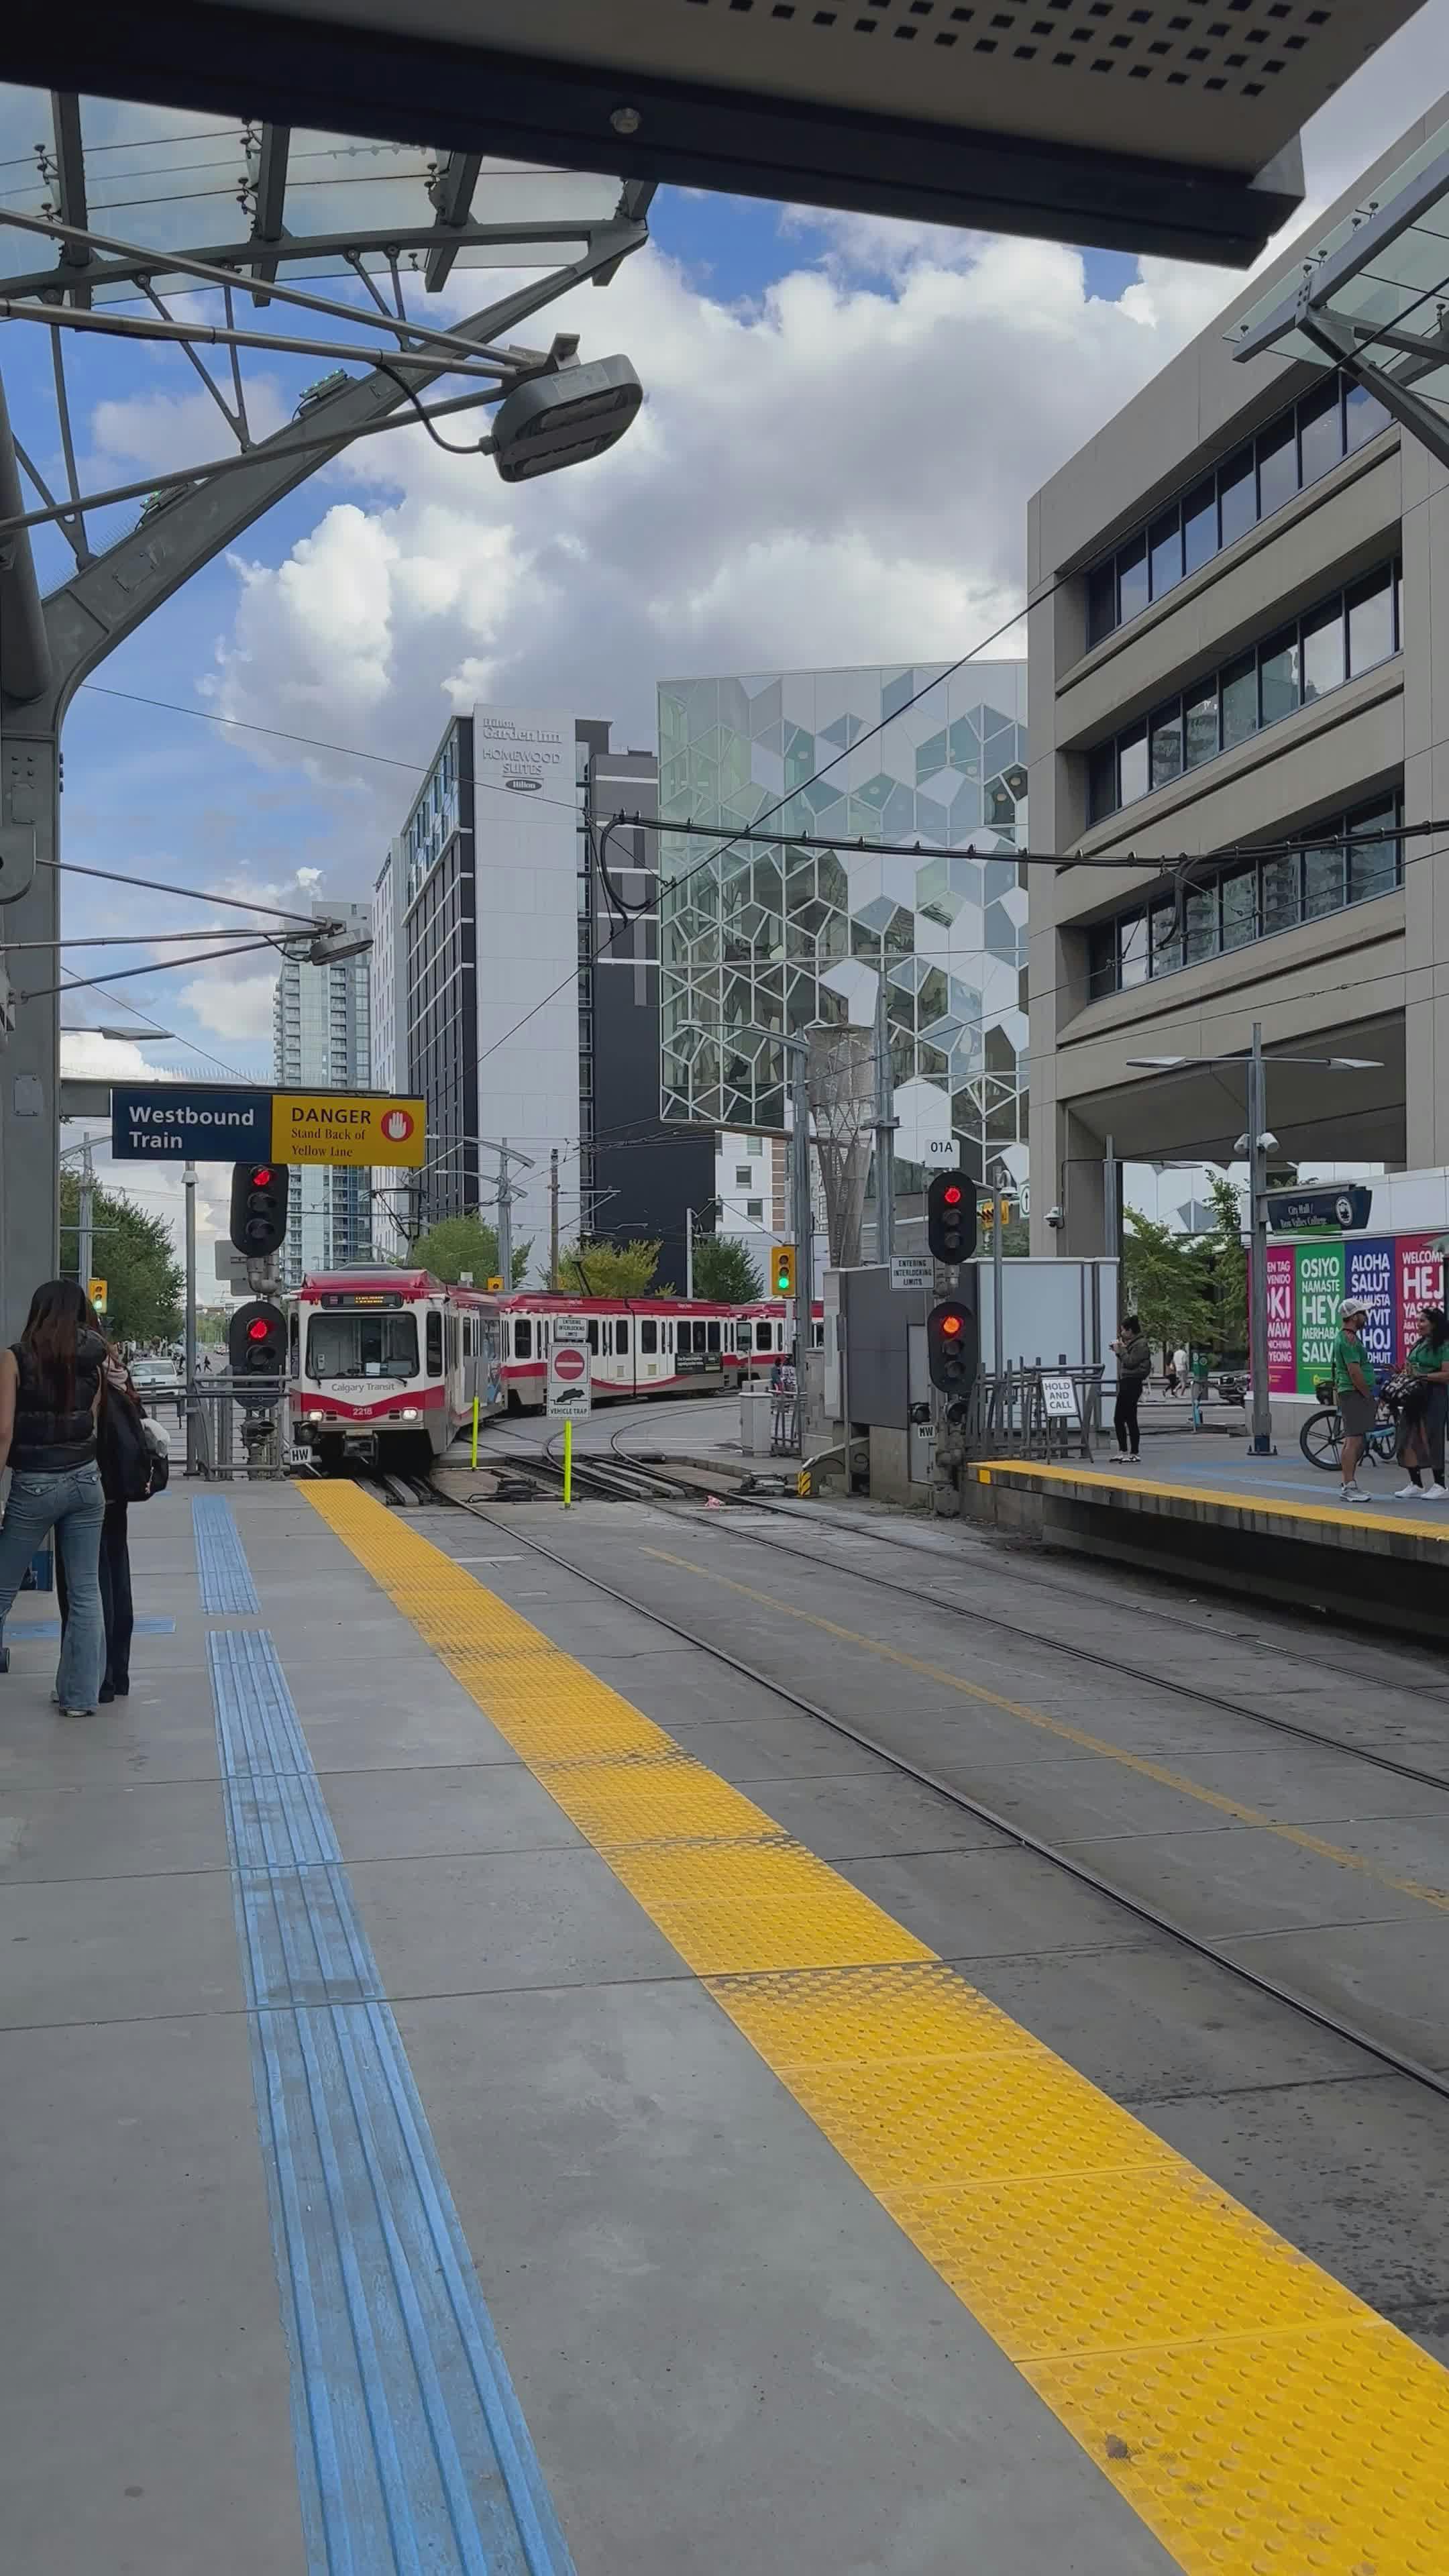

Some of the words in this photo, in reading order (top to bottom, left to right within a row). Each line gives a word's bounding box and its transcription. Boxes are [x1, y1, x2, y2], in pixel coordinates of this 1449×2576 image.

[484, 727, 535, 741] Garden
[537, 730, 562, 743] Inn
[483, 748, 560, 763] HOMEWOOD
[503, 763, 542, 775] SUITES
[129, 1106, 254, 1126] Westbound
[292, 1108, 371, 1124] DANGER
[129, 1131, 183, 1148] Train
[291, 1128, 320, 1139] Stand
[325, 1129, 351, 1140] Back
[355, 1130, 366, 1140] of
[292, 1145, 327, 1157] Yellow
[331, 1146, 353, 1157] Line
[1277, 1260, 1291, 1272] TAG
[1301, 1256, 1340, 1278] OSIYO
[1351, 1252, 1390, 1272] ALOHA
[894, 1269, 932, 1277] INTERLOCKING
[1267, 1274, 1291, 1284] VENIDO
[1302, 1279, 1340, 1293] NAMASTE
[1351, 1272, 1390, 1292] SALUT
[1403, 1265, 1444, 1300] HEJ
[1267, 1286, 1291, 1320] KI
[1302, 1294, 1340, 1325] HEY
[1356, 1328, 1391, 1350] HOJ
[1268, 1351, 1292, 1362] YEONG
[1302, 1341, 1336, 1362] SALV
[331, 1383, 364, 1393] Calgary
[1050, 1391, 1069, 1399] AND
[353, 1407, 373, 1416] 2218
[1049, 1401, 1073, 1409] CALL
[292, 1448, 309, 1461] HW
